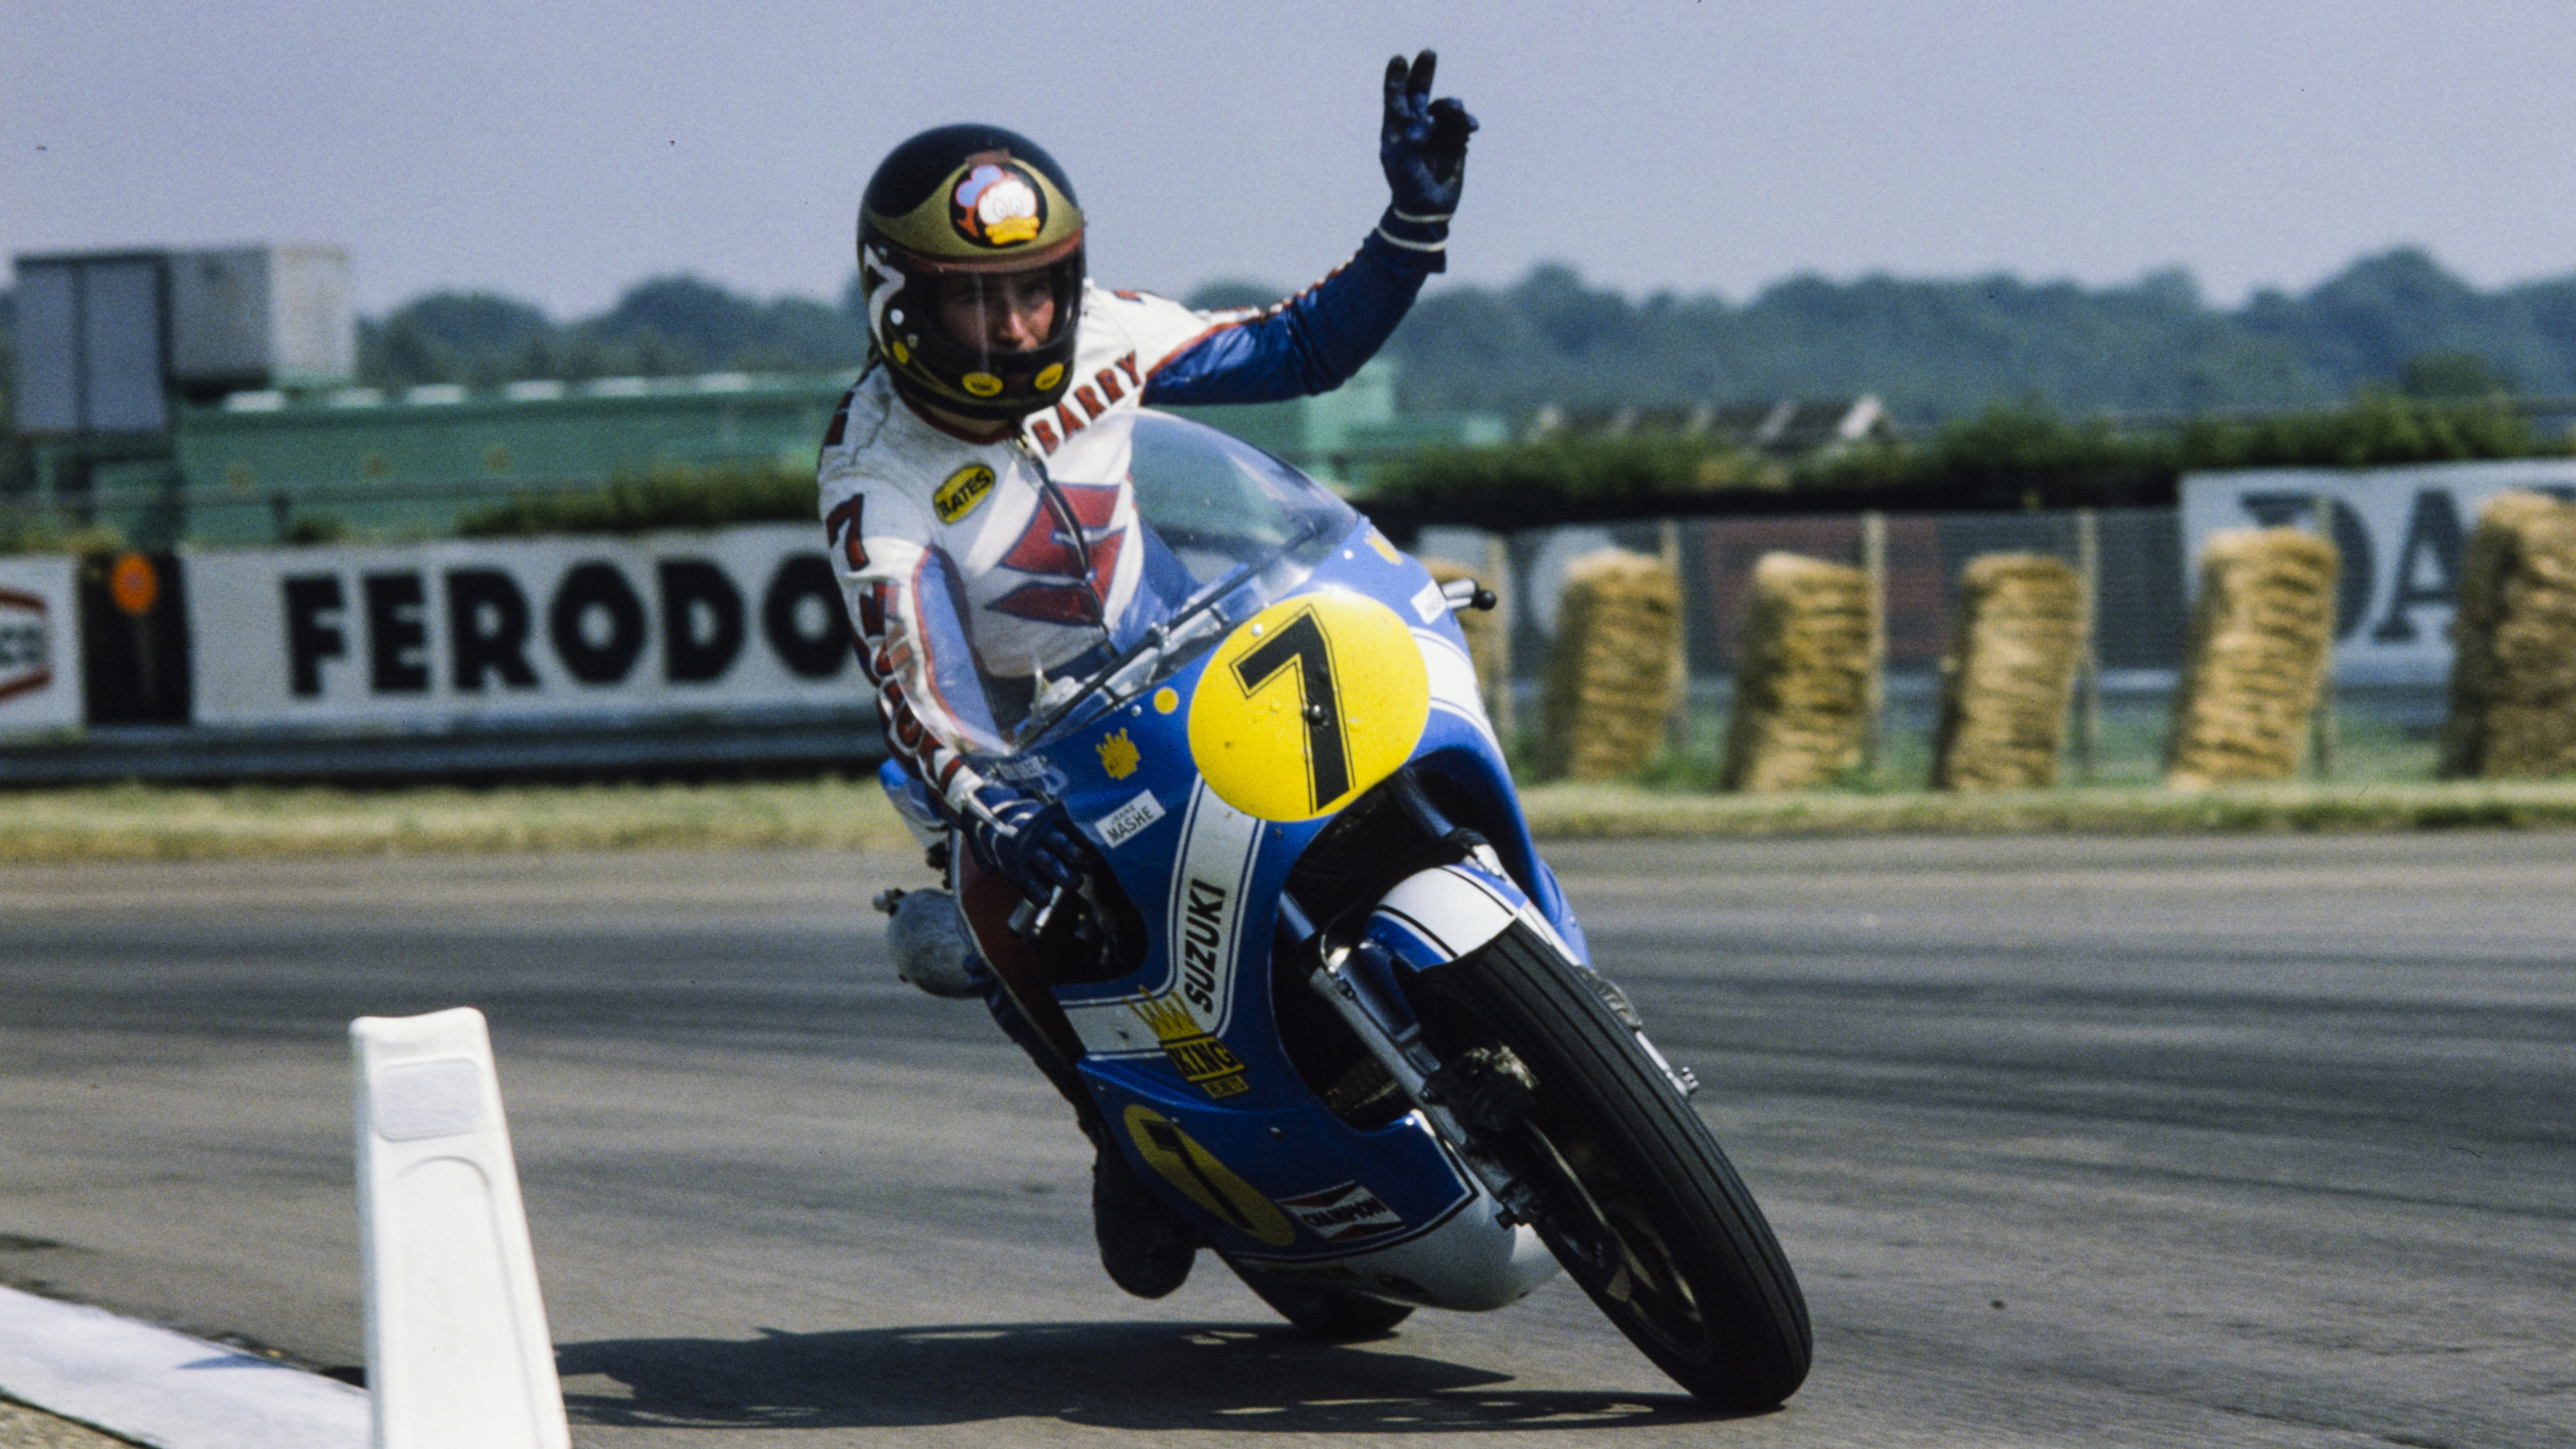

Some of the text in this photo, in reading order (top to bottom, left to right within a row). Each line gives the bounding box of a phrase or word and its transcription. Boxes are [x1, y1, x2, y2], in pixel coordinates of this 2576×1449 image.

[1031, 350, 1140, 457] BARRY
[827, 492, 870, 571] 7
[937, 469, 991, 517] BATES
[283, 555, 855, 698] FERODO
[1229, 603, 1356, 815] 7
[1184, 878, 1226, 1014] SUZUKI
[1167, 1041, 1239, 1077] KING
